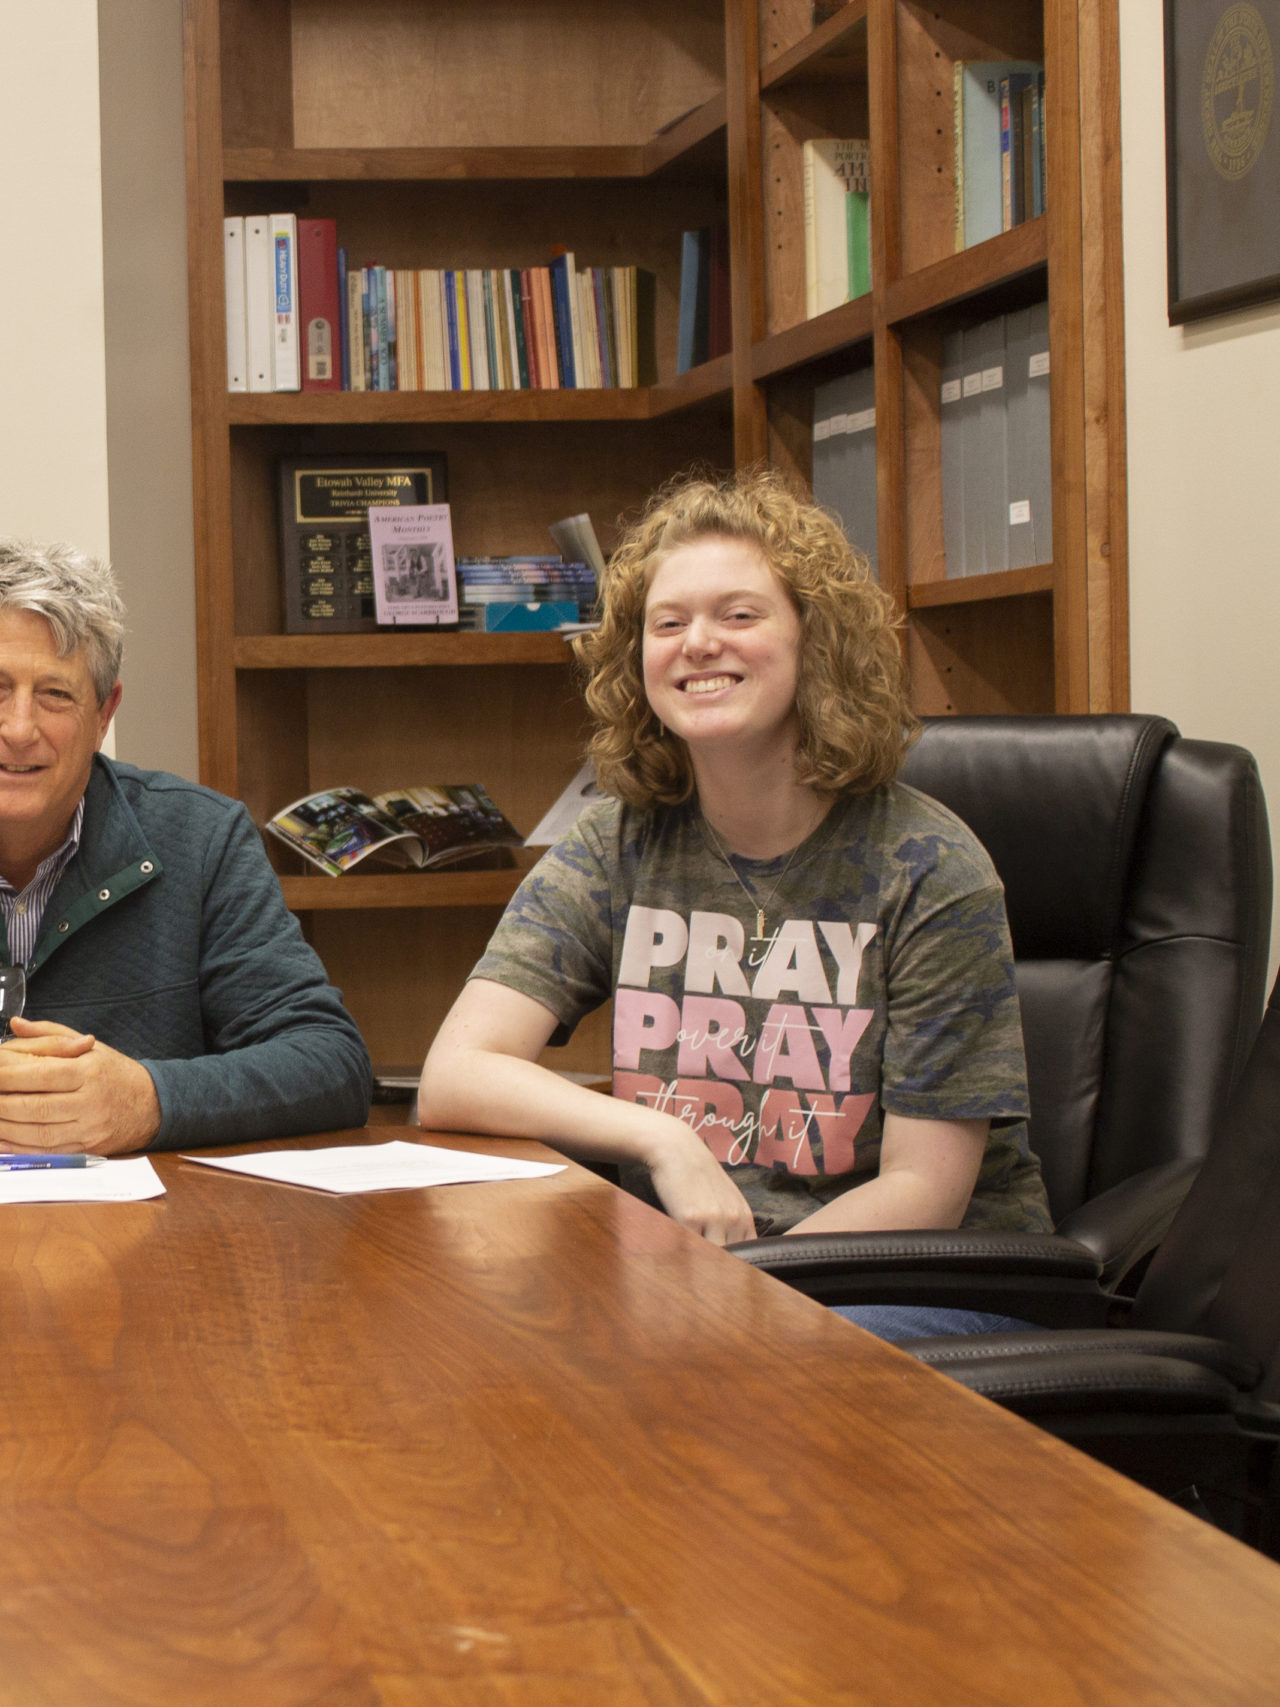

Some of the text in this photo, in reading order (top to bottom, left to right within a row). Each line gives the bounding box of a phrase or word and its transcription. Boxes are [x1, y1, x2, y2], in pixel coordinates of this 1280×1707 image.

[279, 249, 288, 293] HEAVY DUTY
[317, 475, 412, 488] Etowah Valley MFA
[330, 499, 401, 507] TRIVIA CHAMPIONS
[618, 905, 877, 1005] PRAY
[613, 988, 875, 1092] PRAY
[676, 1012, 823, 1081] over it
[789, 1100, 846, 1168] it
